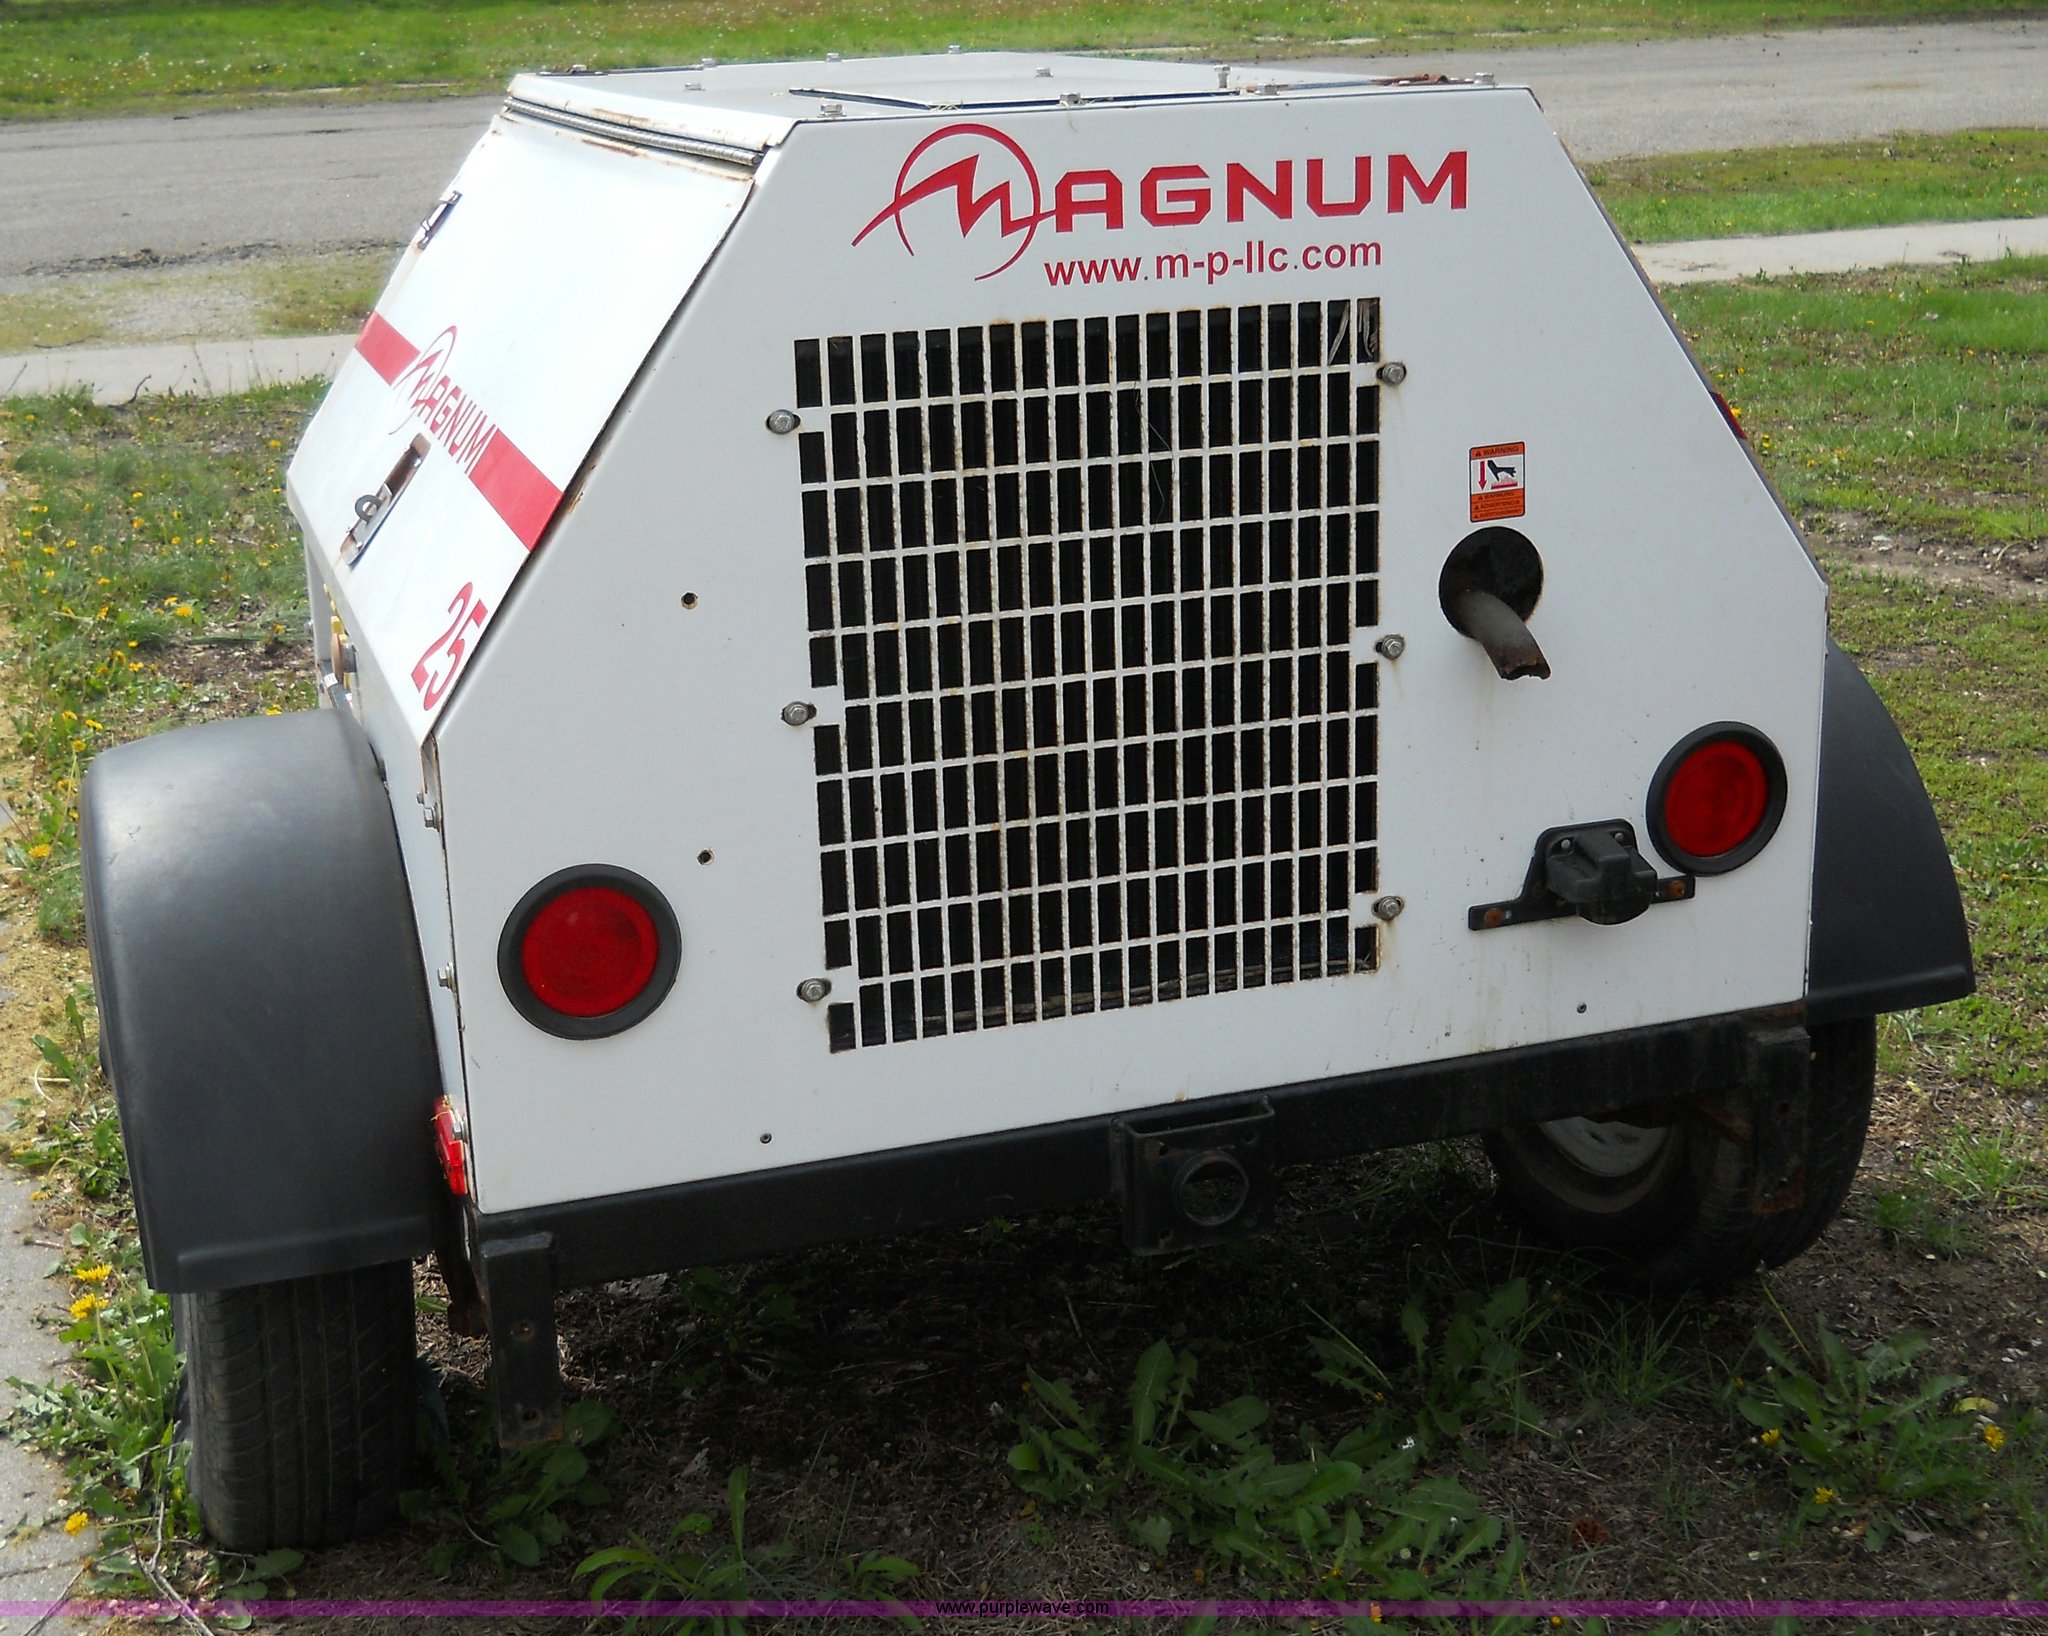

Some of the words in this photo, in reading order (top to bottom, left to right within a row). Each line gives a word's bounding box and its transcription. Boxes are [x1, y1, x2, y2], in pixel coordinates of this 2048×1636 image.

[852, 148, 1468, 248] MAGNUM
[1043, 240, 1382, 287] www.m-p-llc.com
[391, 346, 498, 478] MAGNUM
[410, 581, 489, 712] 25
